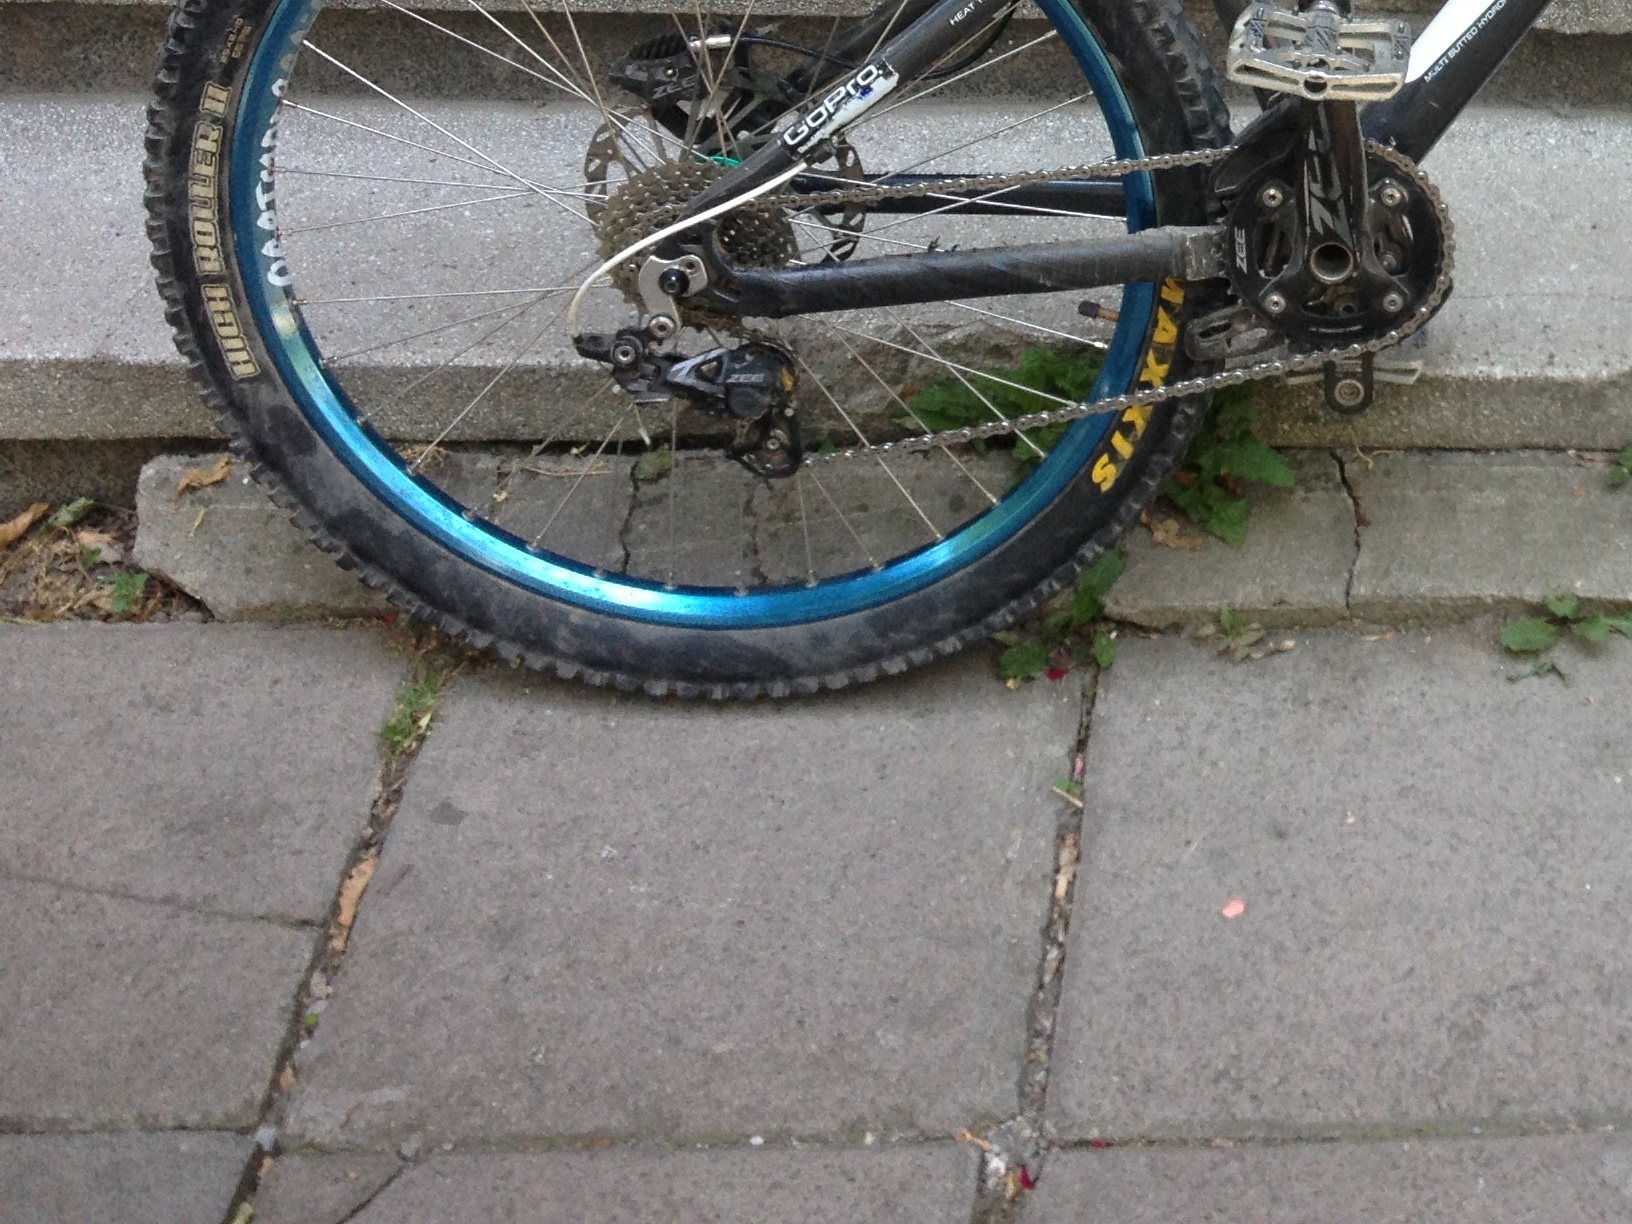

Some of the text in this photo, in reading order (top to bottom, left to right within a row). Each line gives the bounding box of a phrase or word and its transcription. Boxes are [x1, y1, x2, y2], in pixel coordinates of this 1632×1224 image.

[950, 2, 977, 27] HEAT
[1423, 58, 1450, 84] MULTI
[1447, 27, 1479, 60] BUTTED
[187, 117, 225, 277] ROLLER
[200, 282, 261, 380] HIGH
